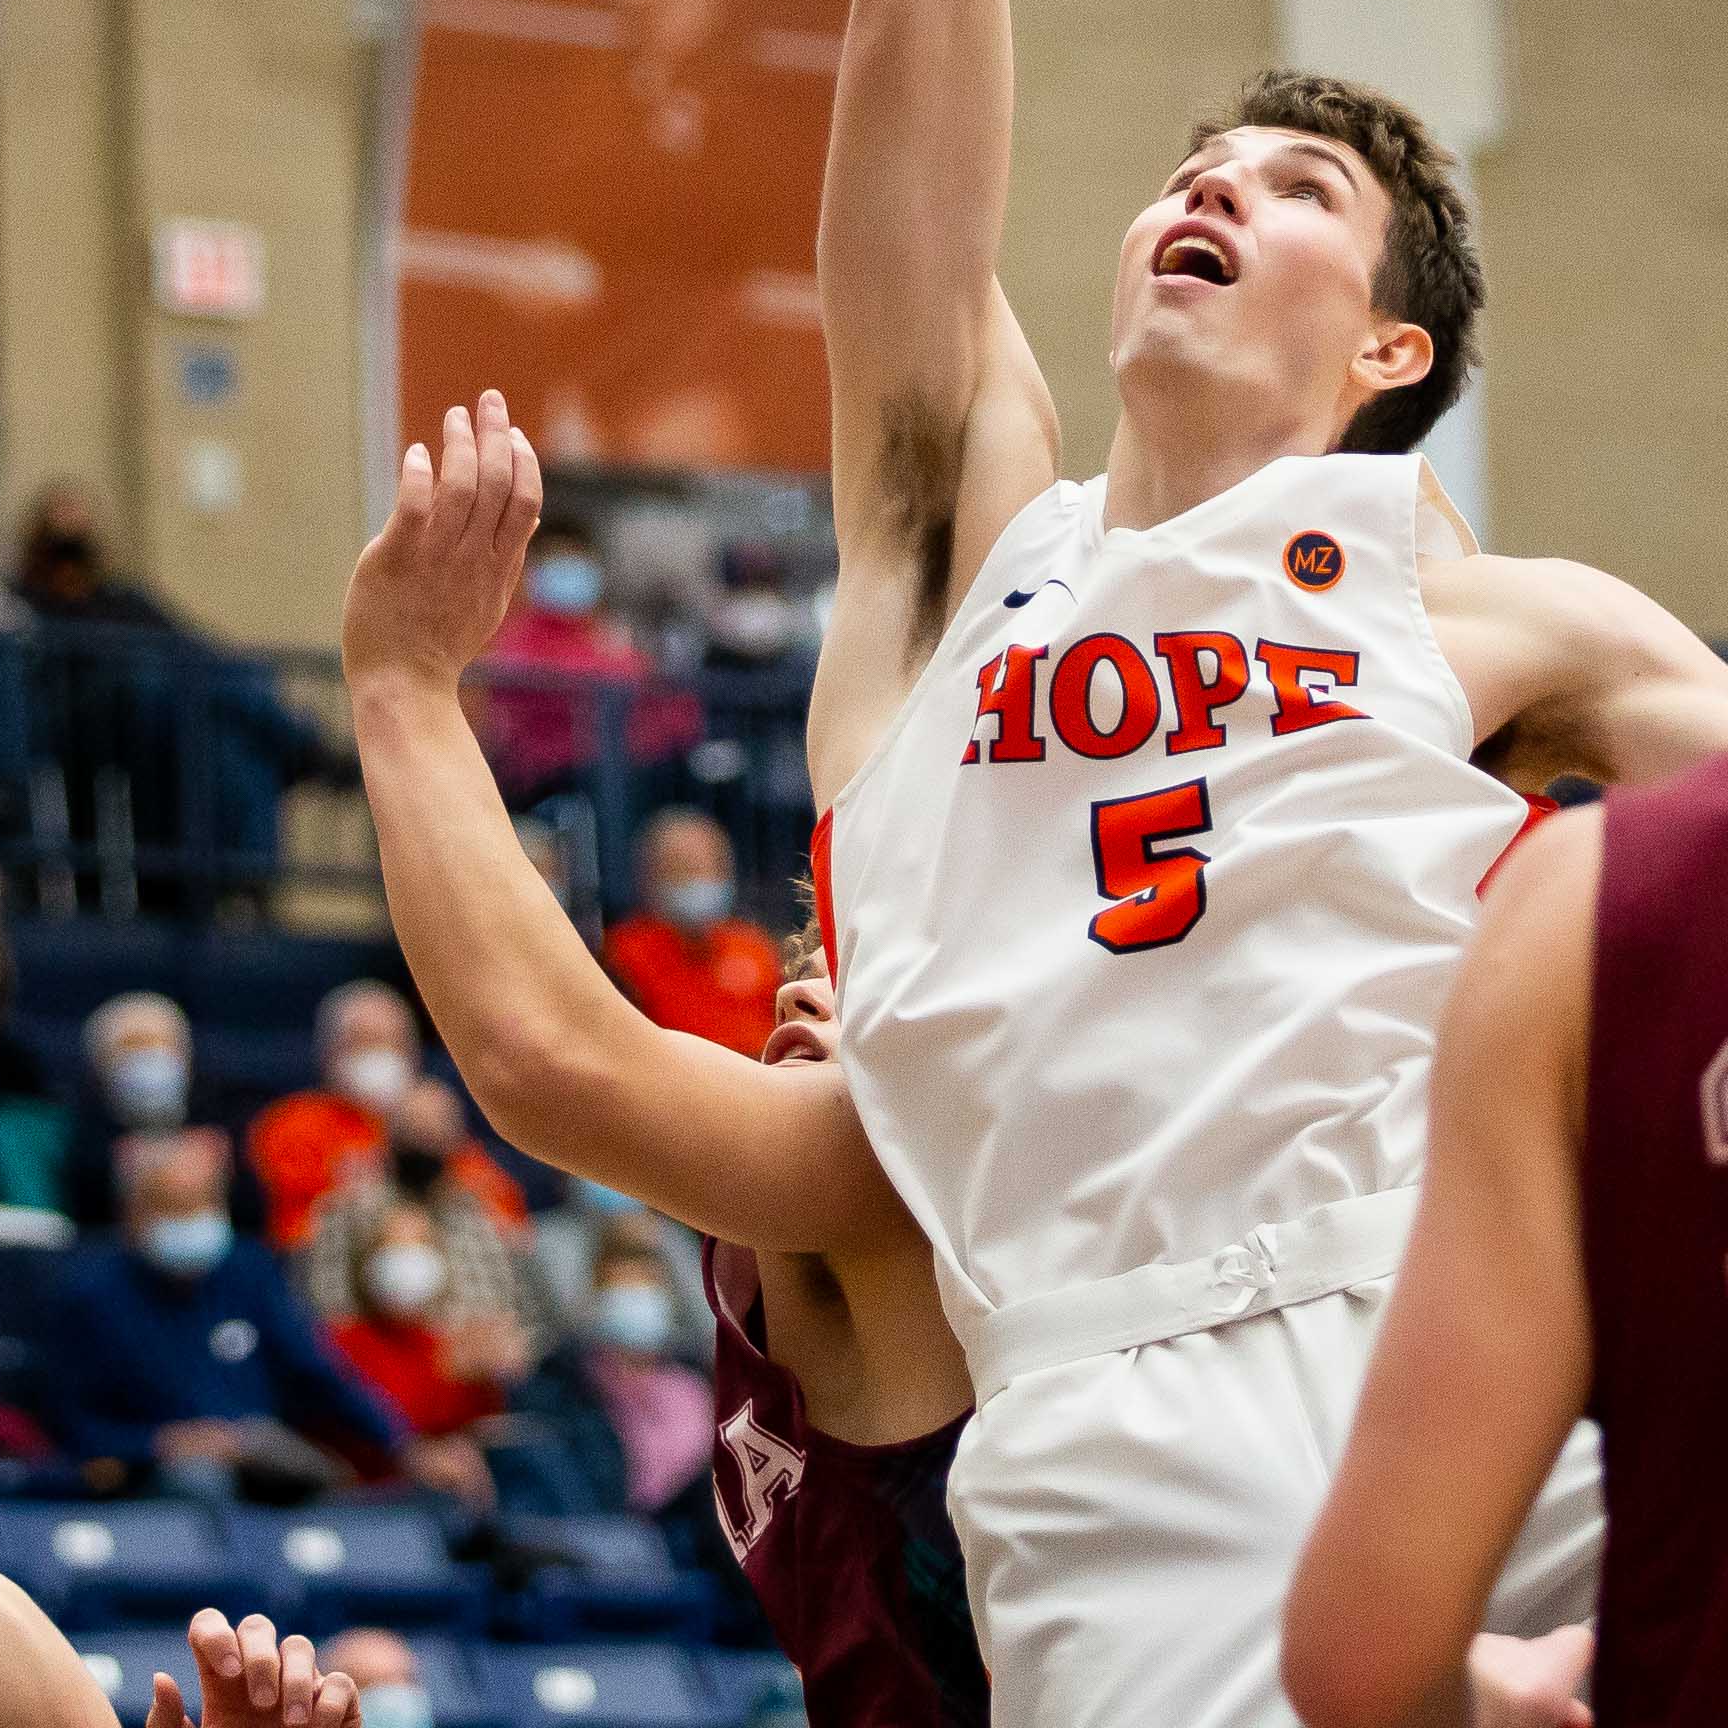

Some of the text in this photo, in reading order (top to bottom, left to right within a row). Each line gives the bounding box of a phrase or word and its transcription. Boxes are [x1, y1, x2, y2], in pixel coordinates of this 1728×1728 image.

[1293, 545, 1337, 574] MZ
[960, 630, 1374, 766] HOPE
[1087, 777, 1213, 956] 5
